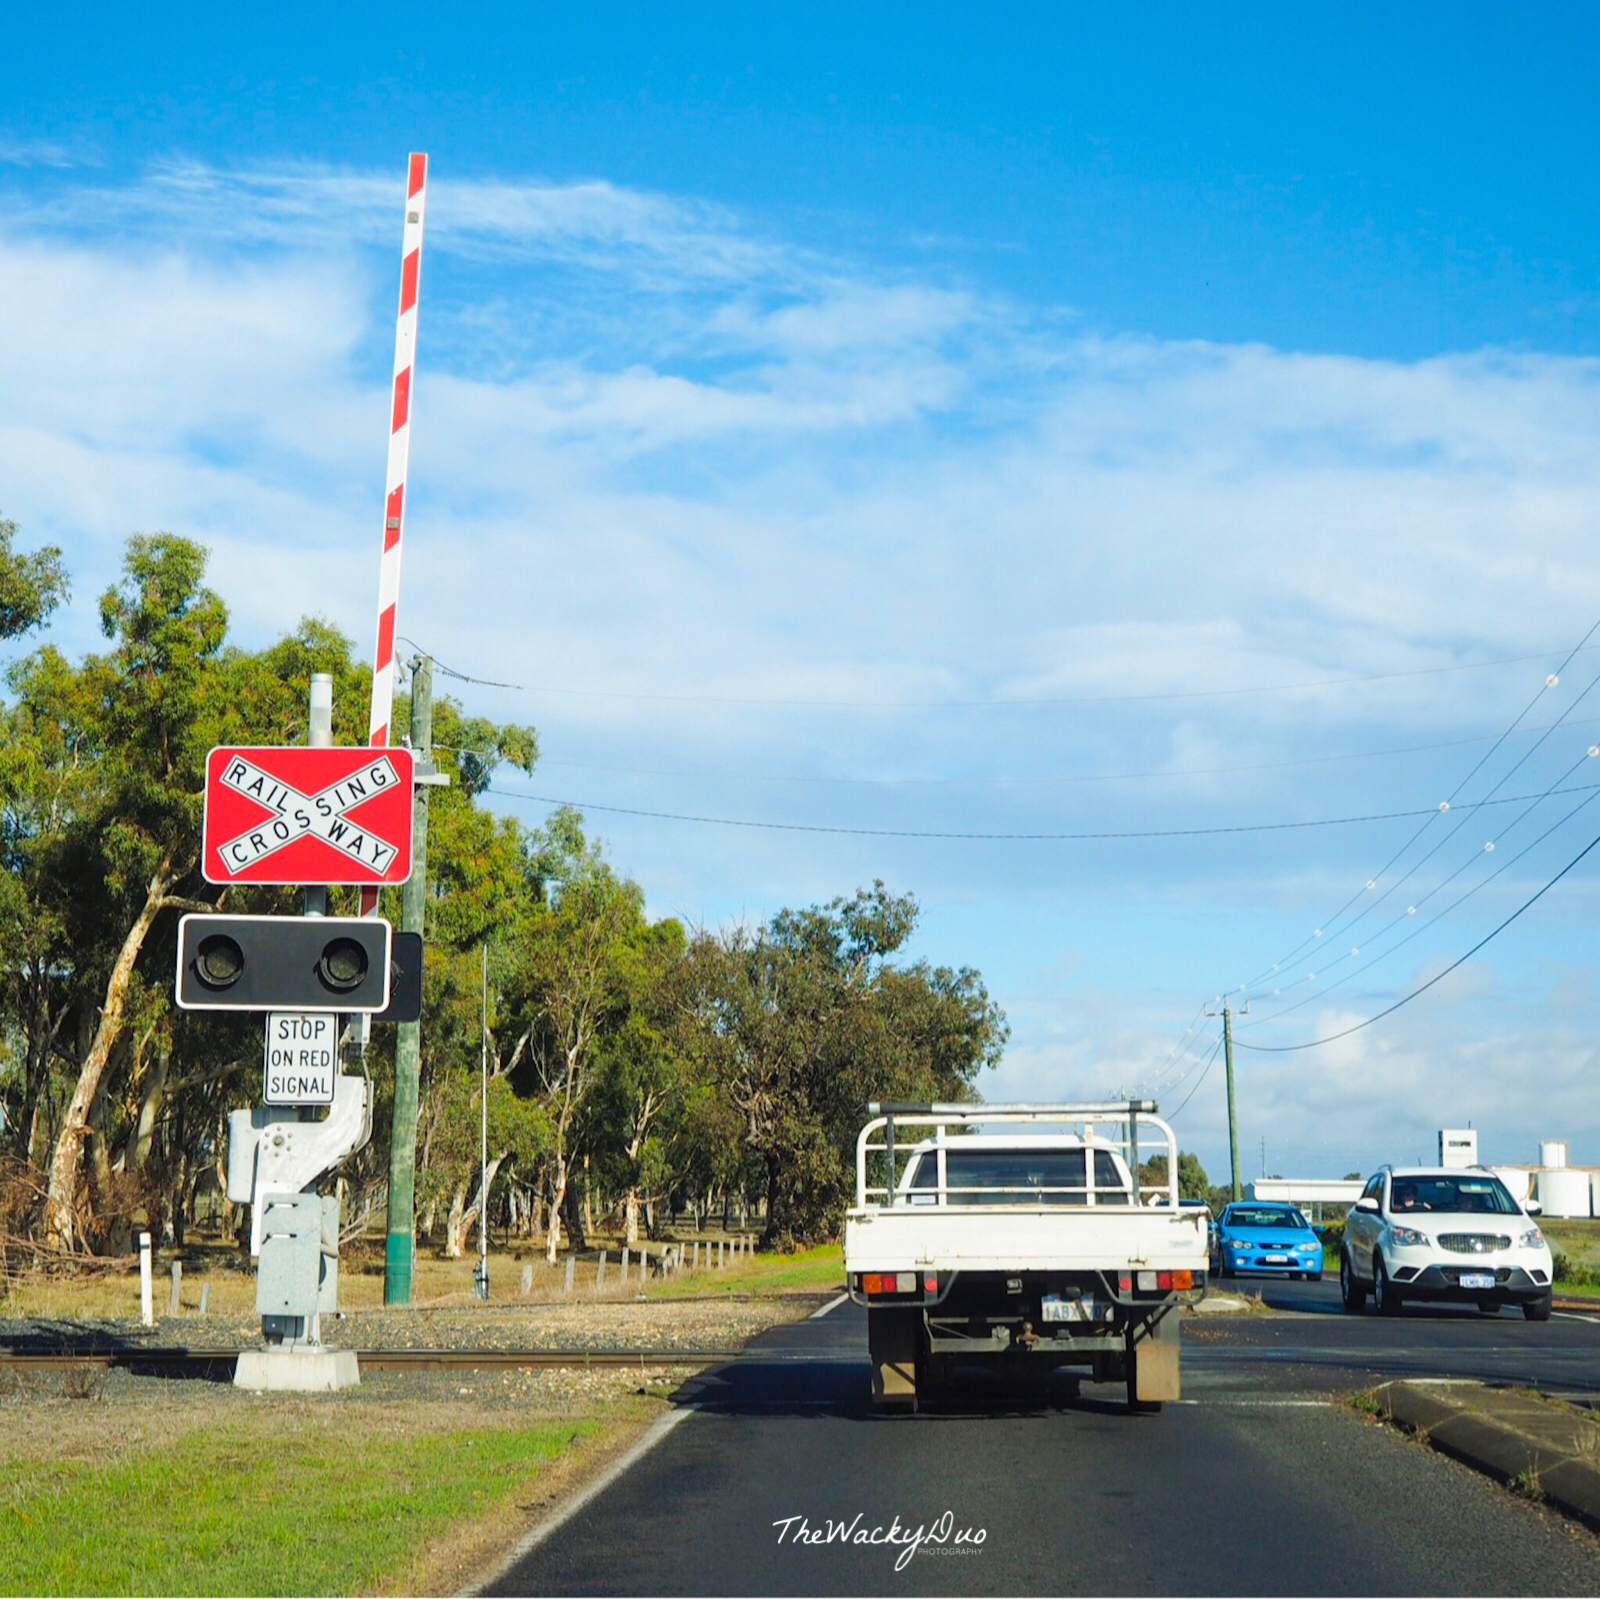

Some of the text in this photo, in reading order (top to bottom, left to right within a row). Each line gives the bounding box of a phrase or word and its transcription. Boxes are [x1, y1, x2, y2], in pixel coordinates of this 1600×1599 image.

[229, 762, 389, 865] RAIL WAY
[231, 766, 388, 863] CROSSING
[278, 1019, 326, 1040] STOP
[271, 1049, 330, 1067] ON RED
[270, 1077, 330, 1094] SIGNAL
